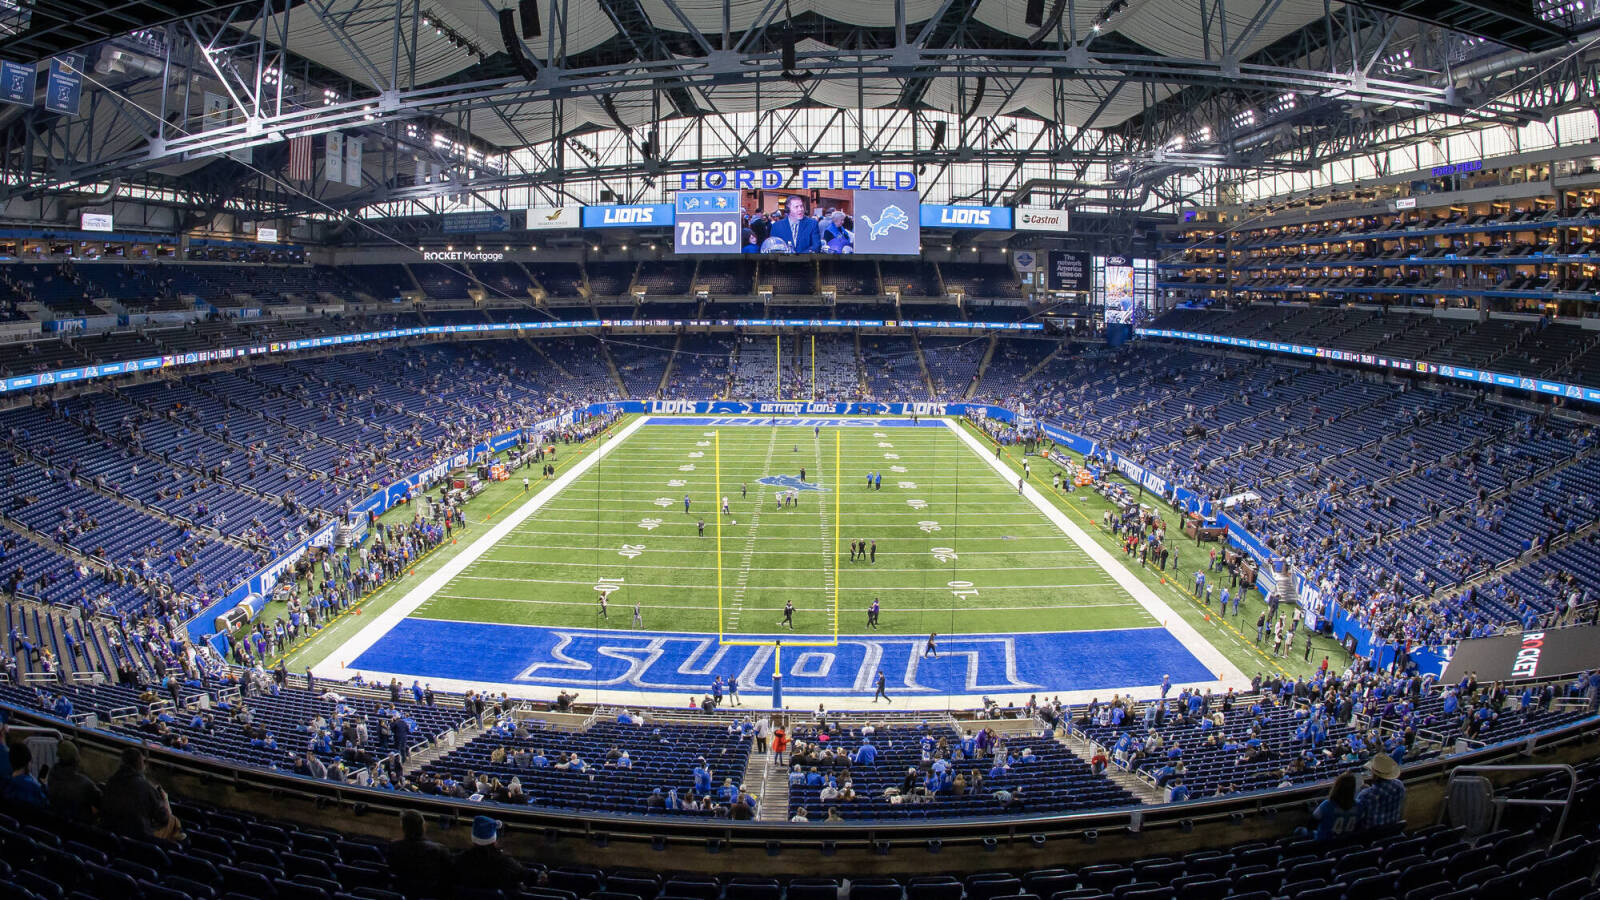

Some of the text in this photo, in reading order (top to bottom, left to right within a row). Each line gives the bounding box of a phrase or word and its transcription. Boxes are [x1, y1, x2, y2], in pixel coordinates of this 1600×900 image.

[1432, 160, 1482, 177] FORD FIELD
[680, 170, 917, 190] FORD FIELD
[603, 207, 654, 224] LIONS
[941, 208, 992, 225] LIONS
[1031, 215, 1060, 225] Castrol
[678, 221, 737, 246] 76:20
[424, 252, 503, 262] ROCKET Mortgage
[652, 400, 697, 414] LIONS
[901, 403, 947, 415] LIONS
[1117, 456, 1166, 498] DETROIT LIONS
[514, 631, 1048, 693] LIONS
[1511, 632, 1545, 677] ROCKET
